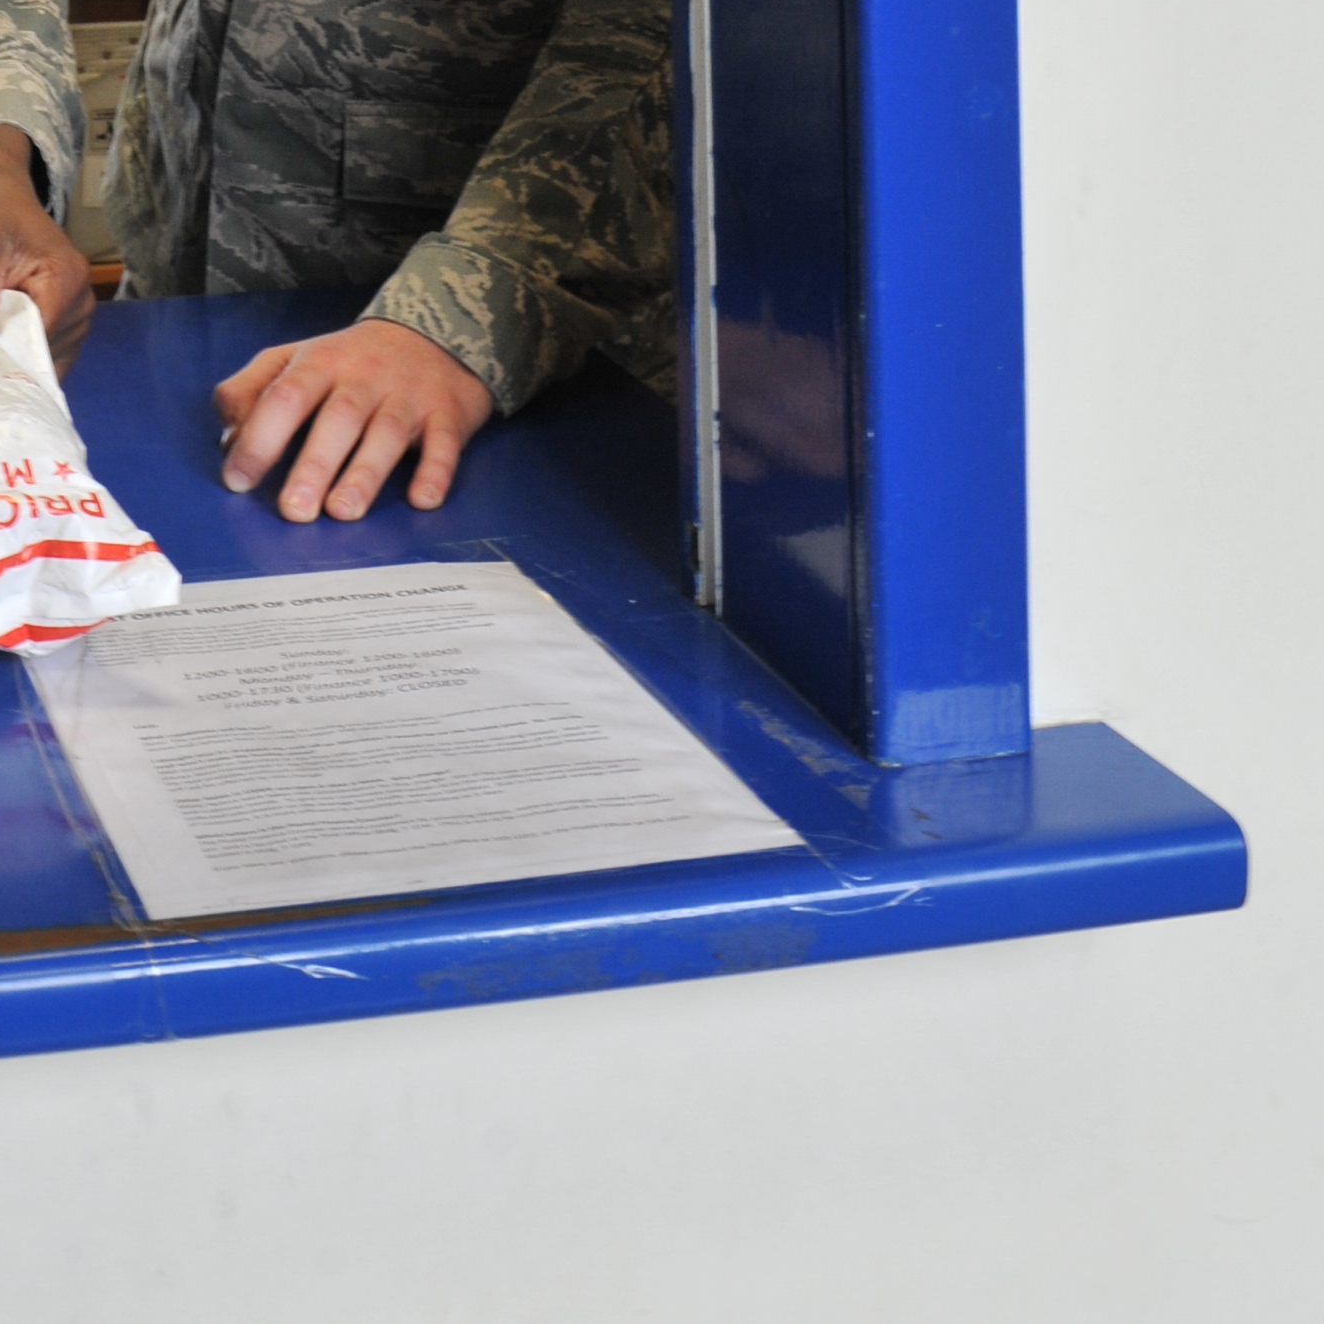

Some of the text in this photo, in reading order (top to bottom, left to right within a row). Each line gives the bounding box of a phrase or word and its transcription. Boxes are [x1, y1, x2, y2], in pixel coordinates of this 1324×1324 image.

[131, 608, 191, 621] OFFICE
[196, 602, 260, 615] HOURS
[262, 600, 286, 609] OF
[289, 591, 393, 607] OPERATION
[395, 583, 469, 598] CHANGE
[396, 678, 469, 693] CLOSED
